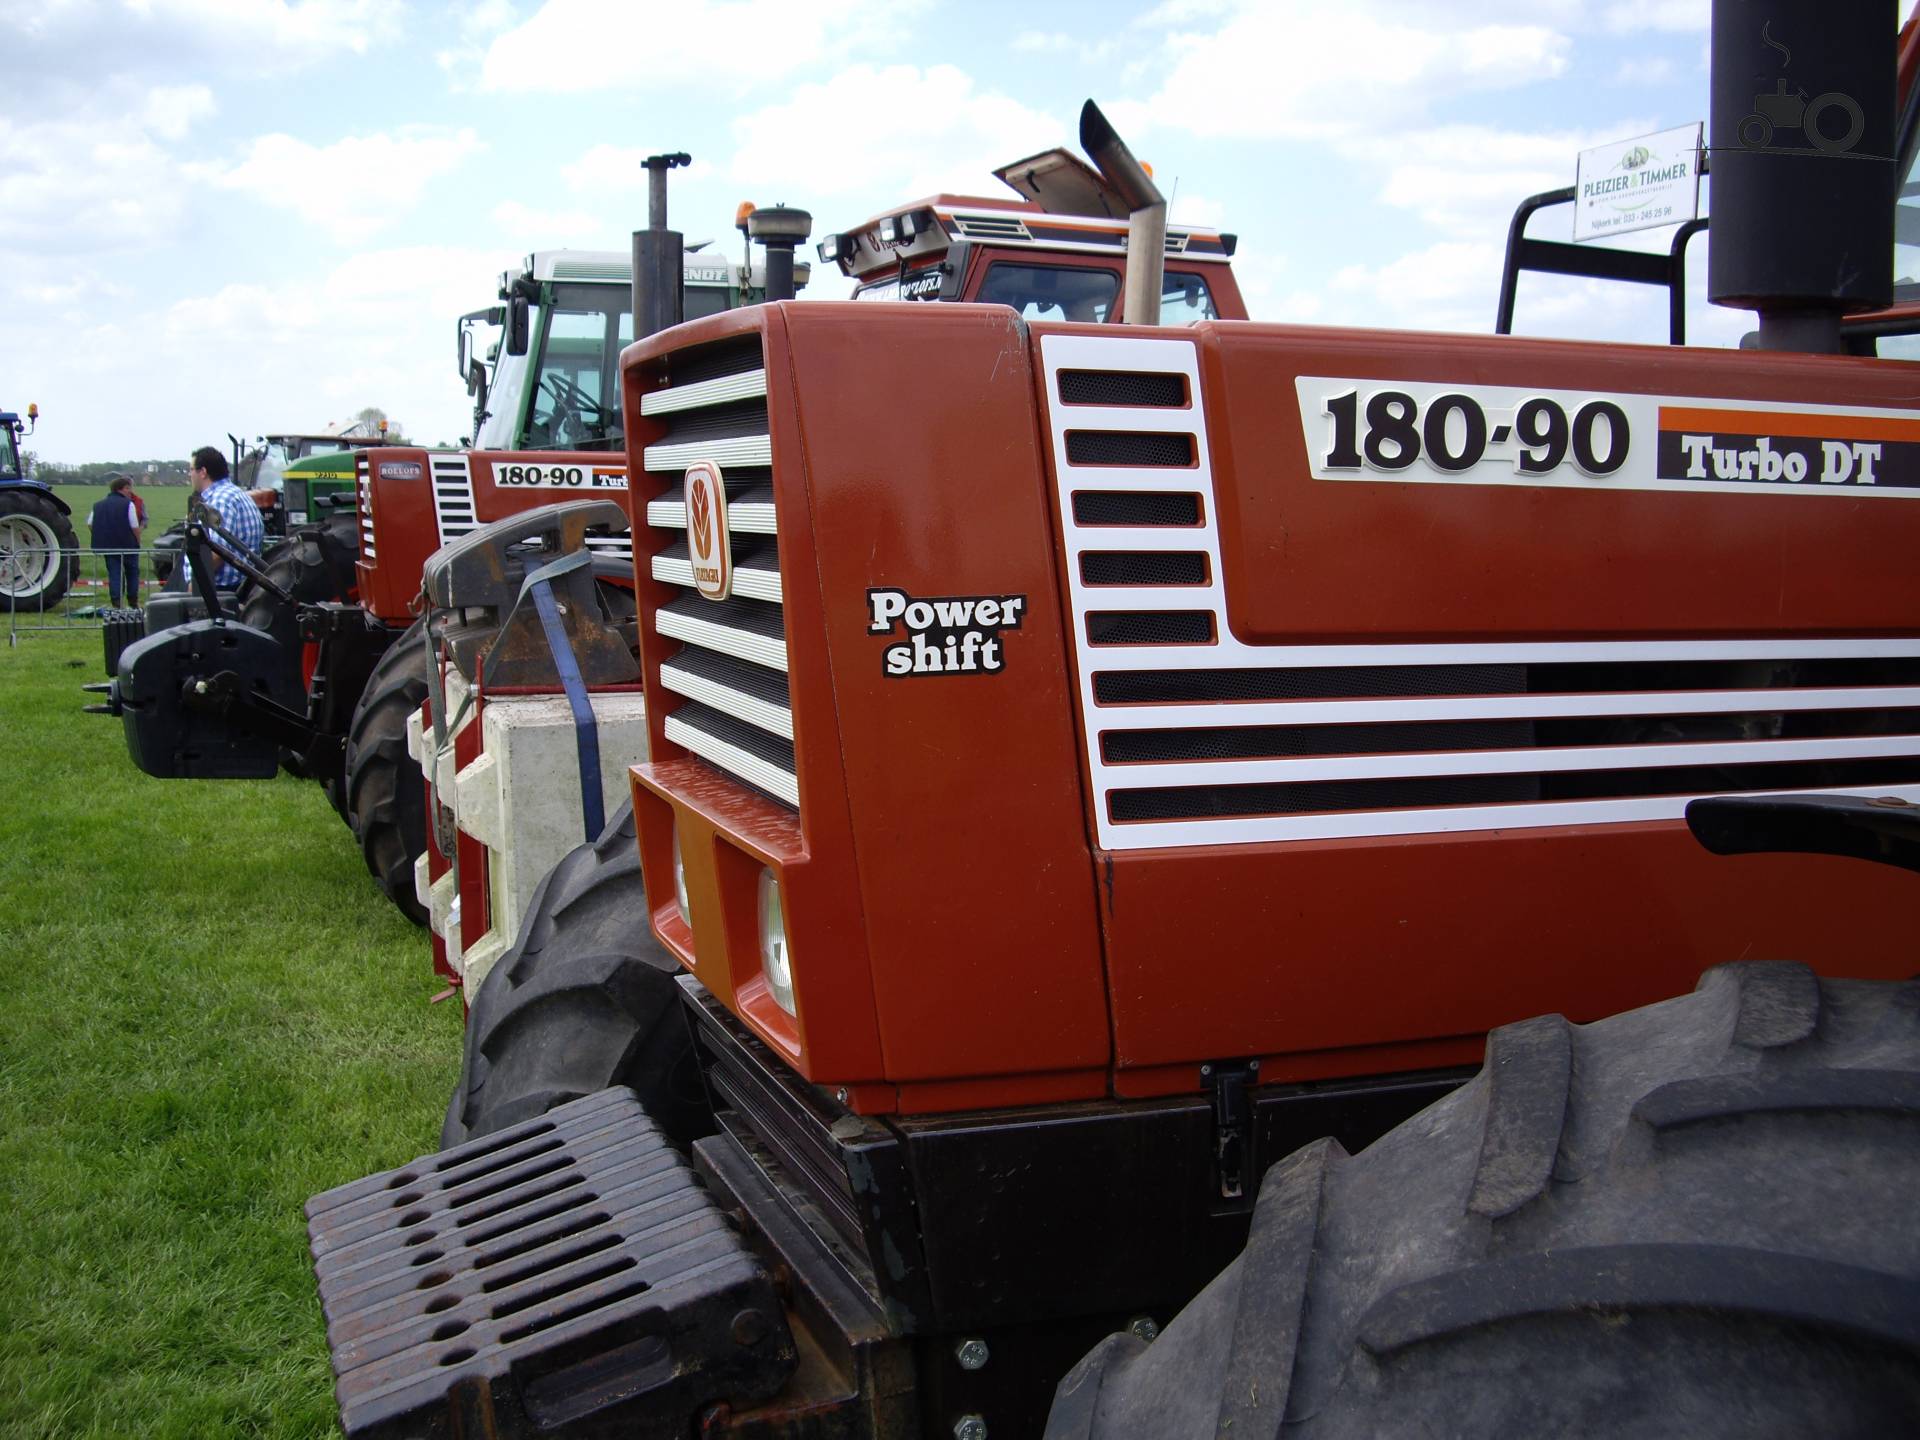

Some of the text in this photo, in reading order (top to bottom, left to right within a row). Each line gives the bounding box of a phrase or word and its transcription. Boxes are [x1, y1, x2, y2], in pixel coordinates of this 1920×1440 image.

[1584, 175, 1629, 197] PLEIZIER
[1640, 163, 1687, 186] TIMMER
[1324, 390, 1882, 485] 180-90 Turbo DT
[499, 466, 583, 486] 180-90
[870, 592, 1022, 631] Power
[887, 631, 1001, 675] shift
